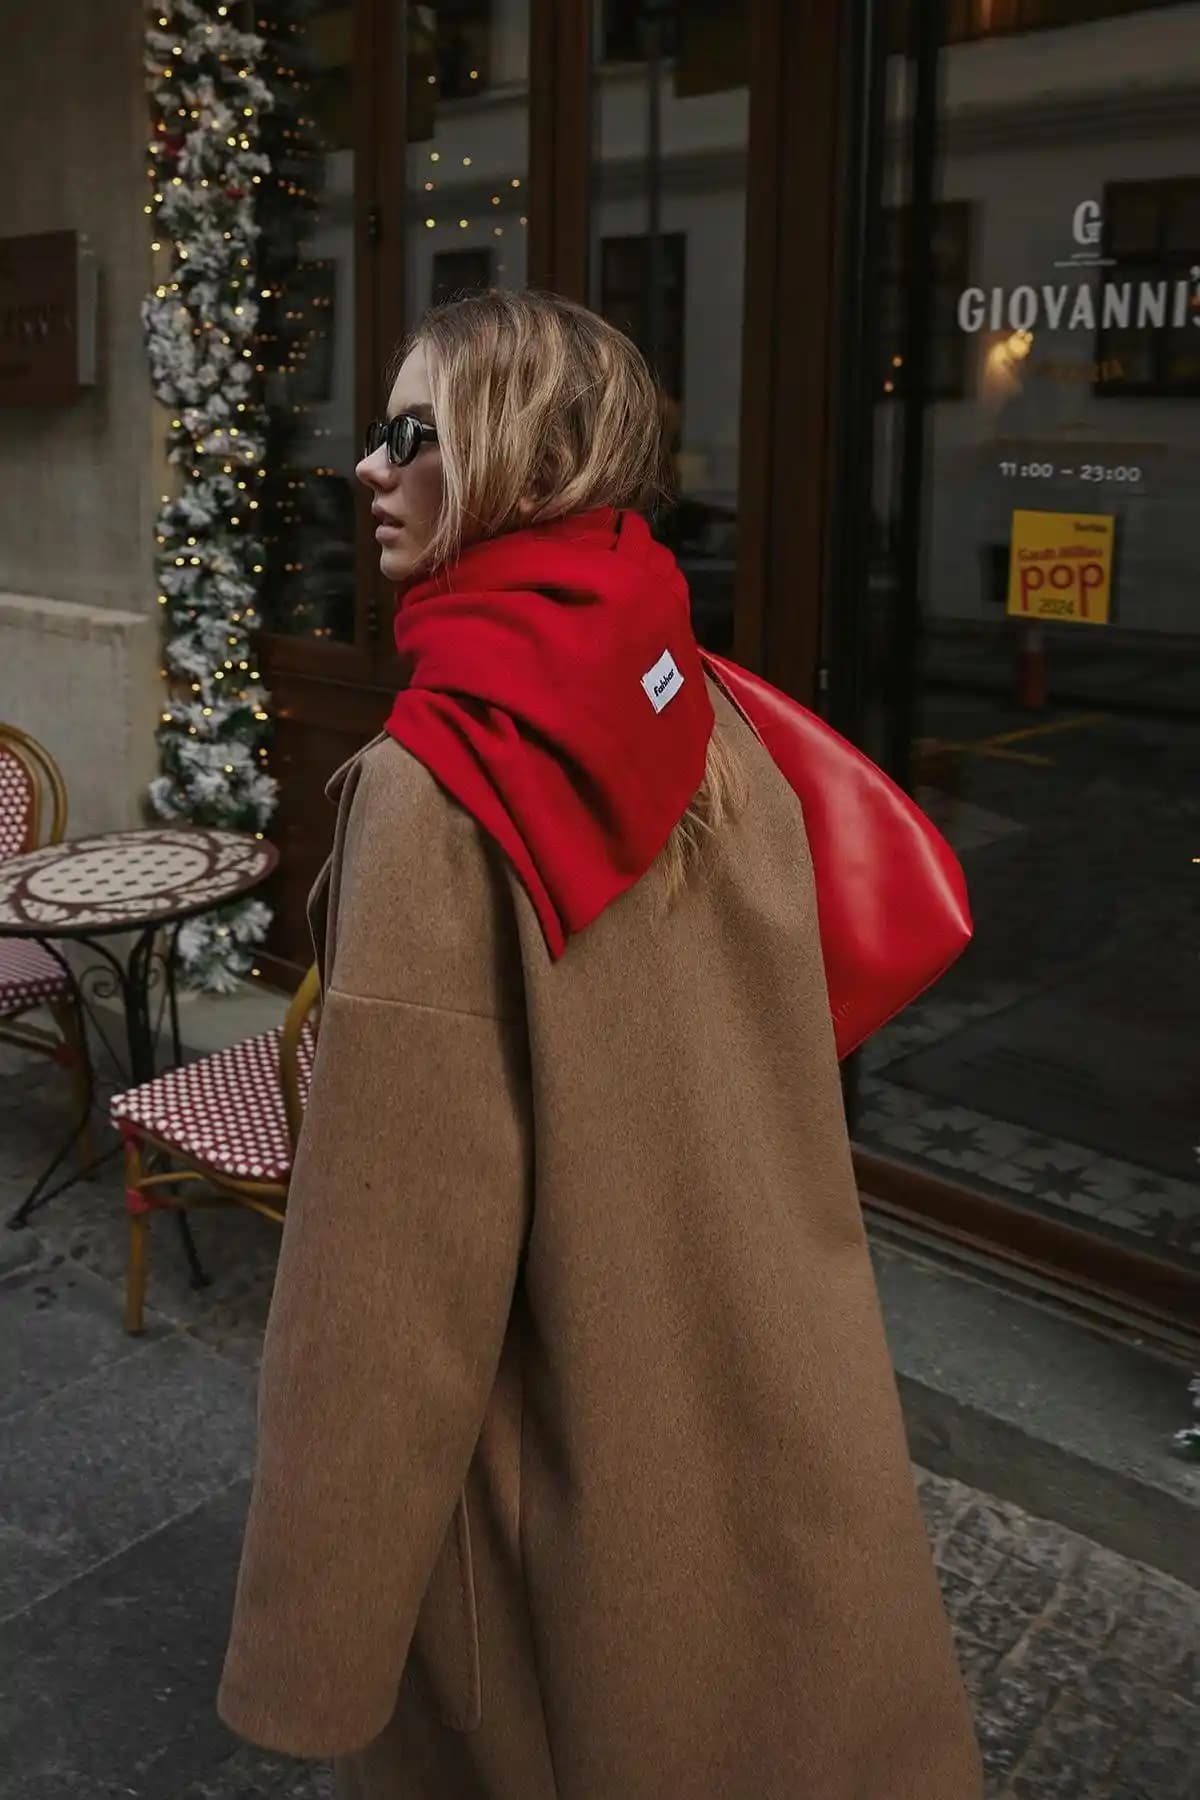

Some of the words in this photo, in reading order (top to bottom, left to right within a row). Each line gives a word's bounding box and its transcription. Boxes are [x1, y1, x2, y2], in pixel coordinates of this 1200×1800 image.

[1072, 200, 1103, 245] G
[999, 461, 1054, 478] 11:00
[1079, 464, 1142, 482] 23:00
[1020, 561, 1104, 618] pop
